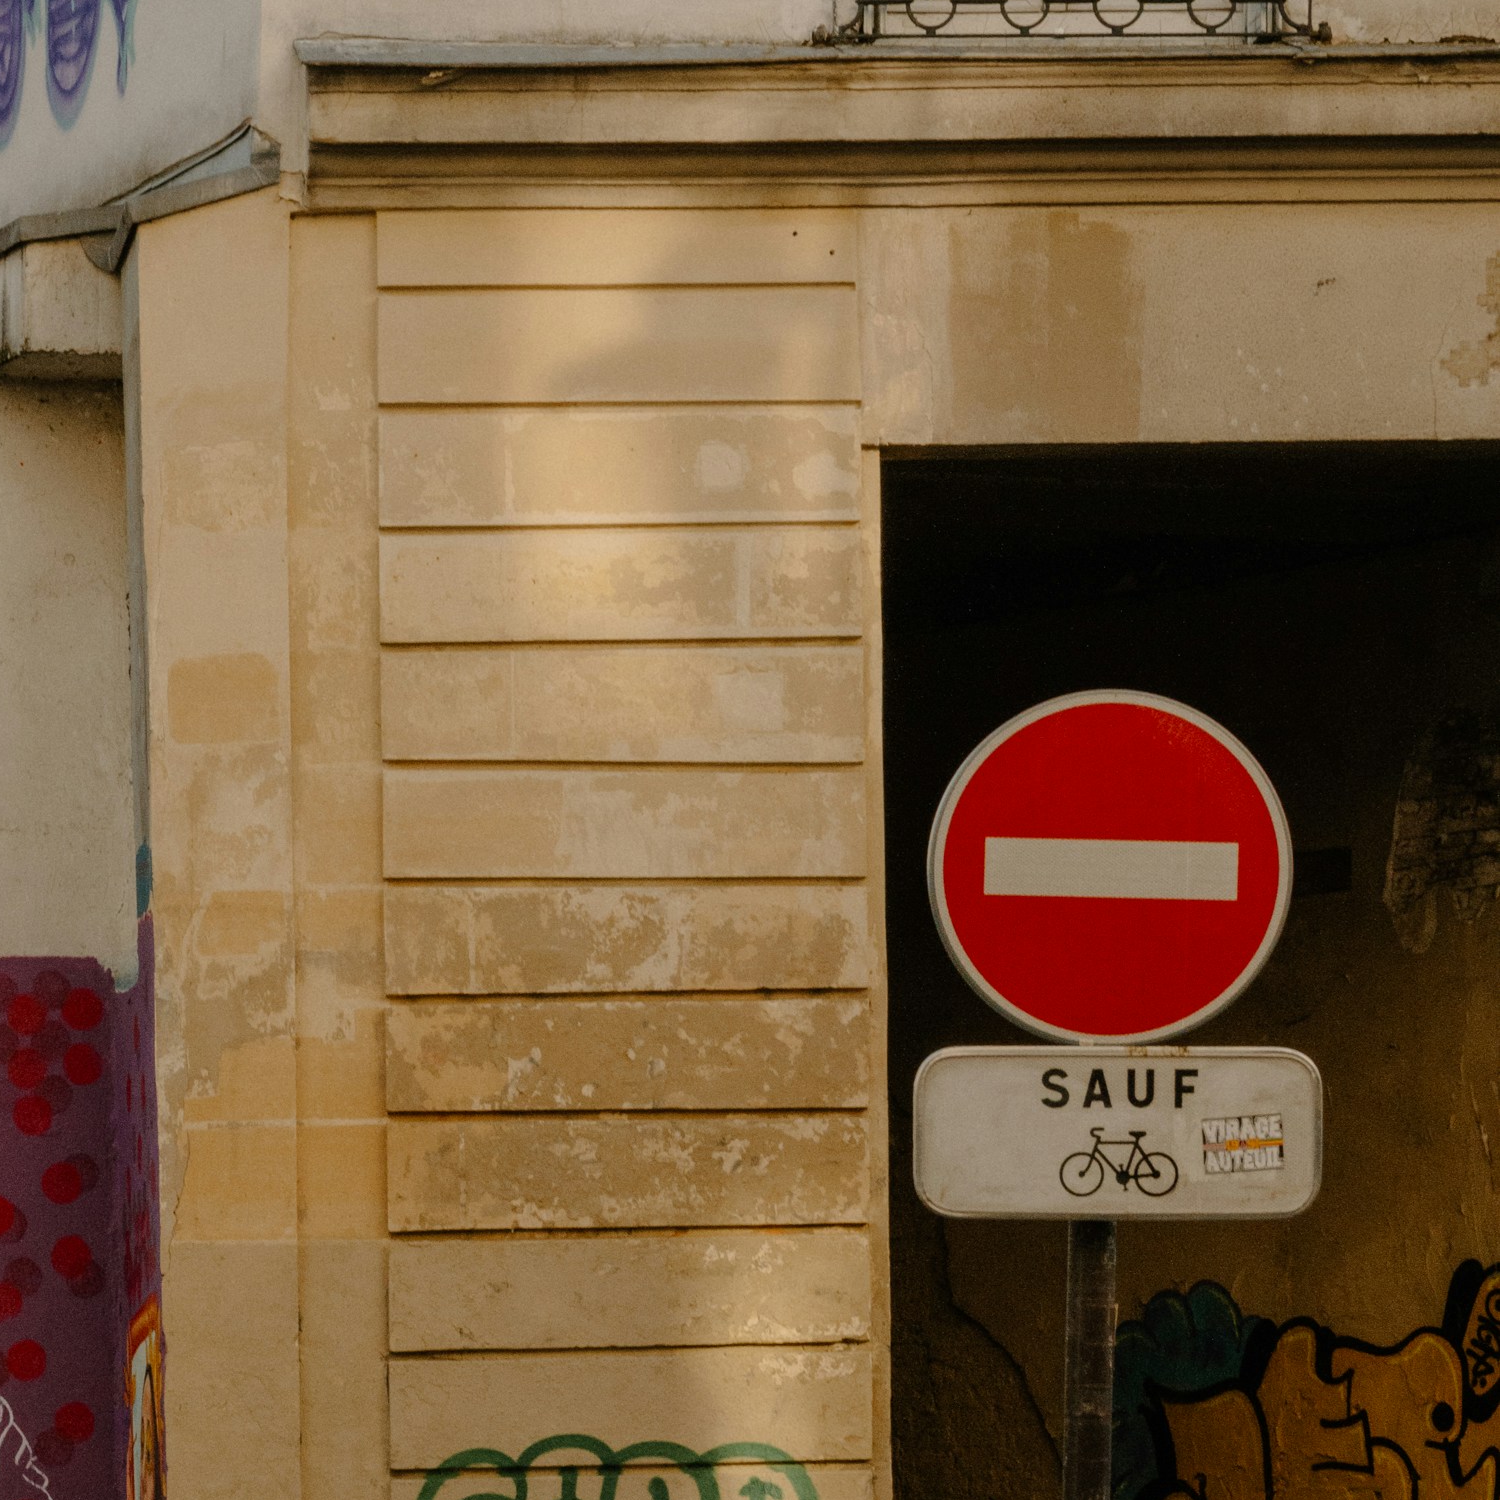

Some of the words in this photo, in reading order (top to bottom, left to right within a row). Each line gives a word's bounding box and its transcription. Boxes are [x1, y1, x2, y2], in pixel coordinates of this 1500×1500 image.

[1041, 1068, 1199, 1109] SAUF
[1202, 1115, 1283, 1144] VIRAGE
[1205, 1145, 1282, 1173] AUTEUIL
